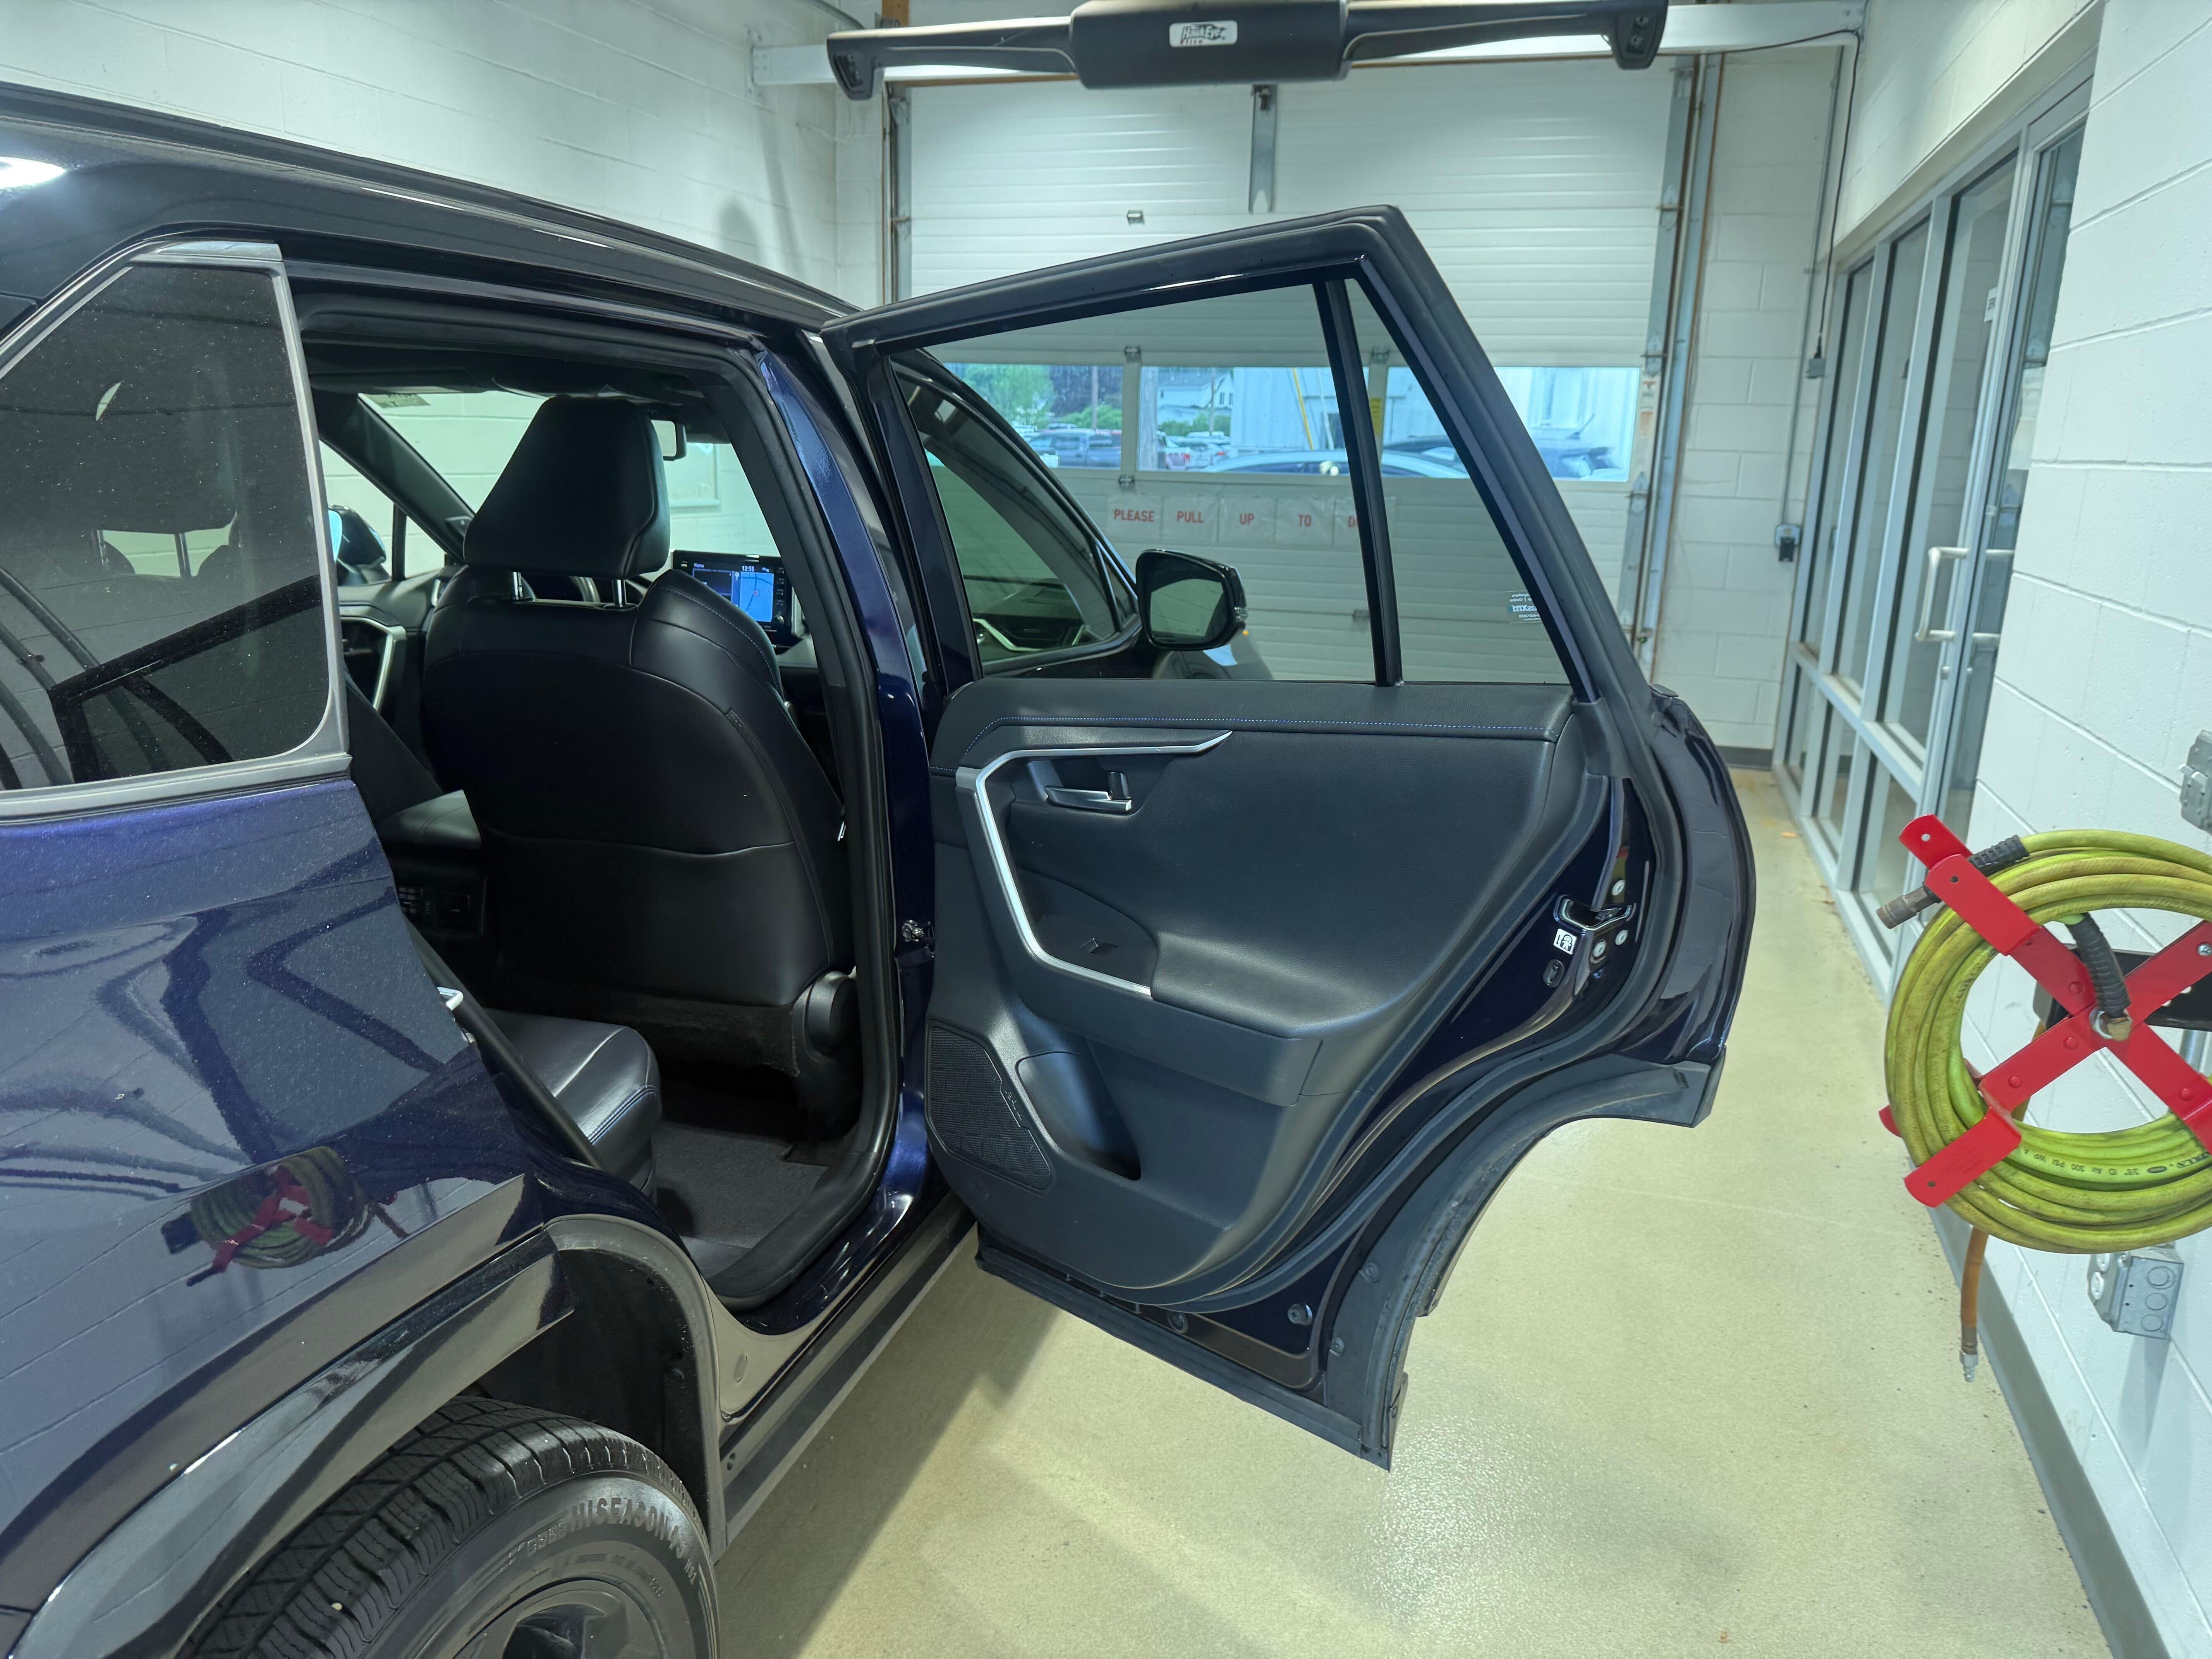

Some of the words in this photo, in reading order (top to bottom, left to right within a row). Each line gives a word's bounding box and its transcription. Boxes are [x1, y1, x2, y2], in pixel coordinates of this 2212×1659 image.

[1114, 508, 1155, 522] PLEASE
[1177, 511, 1204, 523] PULL
[1240, 513, 1254, 525] UP
[1298, 514, 1312, 527] TO
[2052, 1159, 2064, 1167] PSI
[2071, 1163, 2085, 1171] 300
